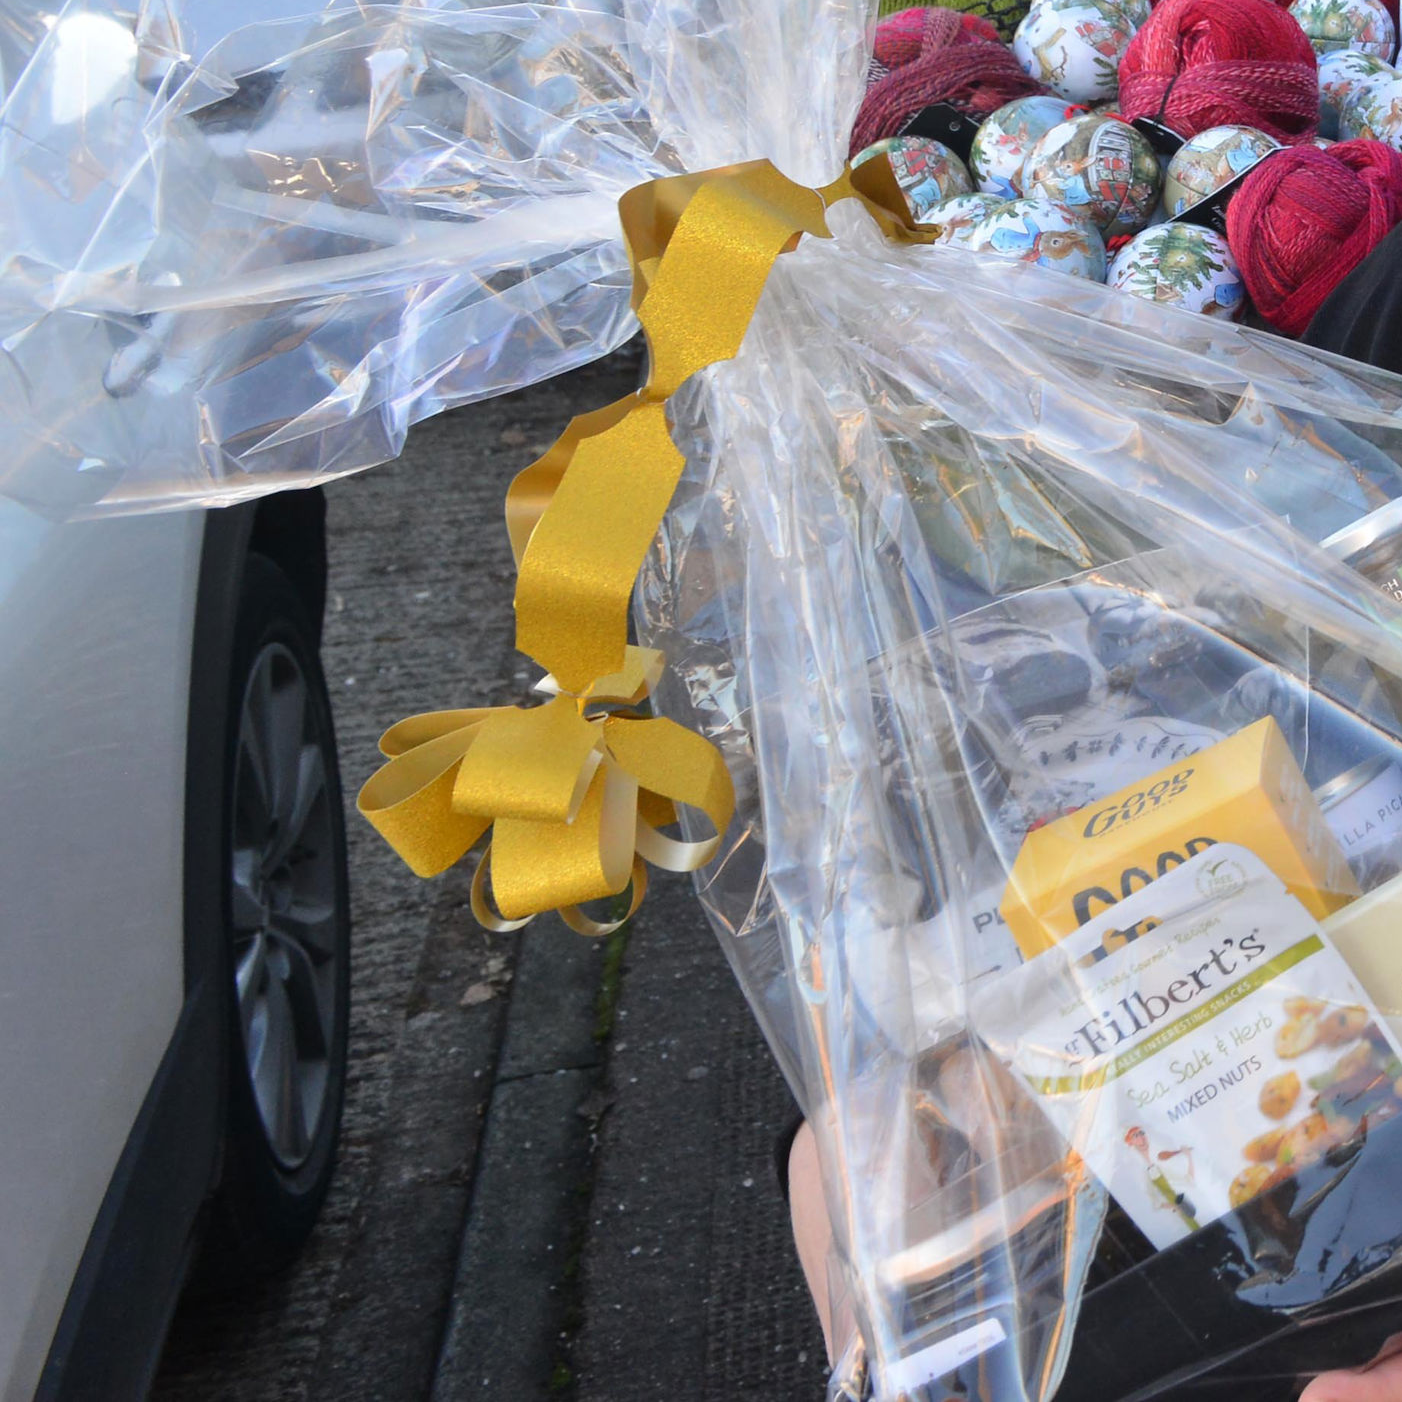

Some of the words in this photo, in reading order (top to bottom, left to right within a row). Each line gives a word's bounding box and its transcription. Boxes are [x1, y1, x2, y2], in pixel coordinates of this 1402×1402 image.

[1083, 768, 1195, 838] GOOD
[1073, 932, 1267, 1060] Filbert's
[1143, 1009, 1211, 1052] INTERESTING
[1210, 981, 1251, 1014] SNACKS
[1127, 1081, 1170, 1109] Sea
[1169, 1049, 1213, 1085] Salt
[1229, 1010, 1273, 1048] Herb
[1167, 1083, 1218, 1123] MIXED
[1218, 1054, 1262, 1091] NUTS
